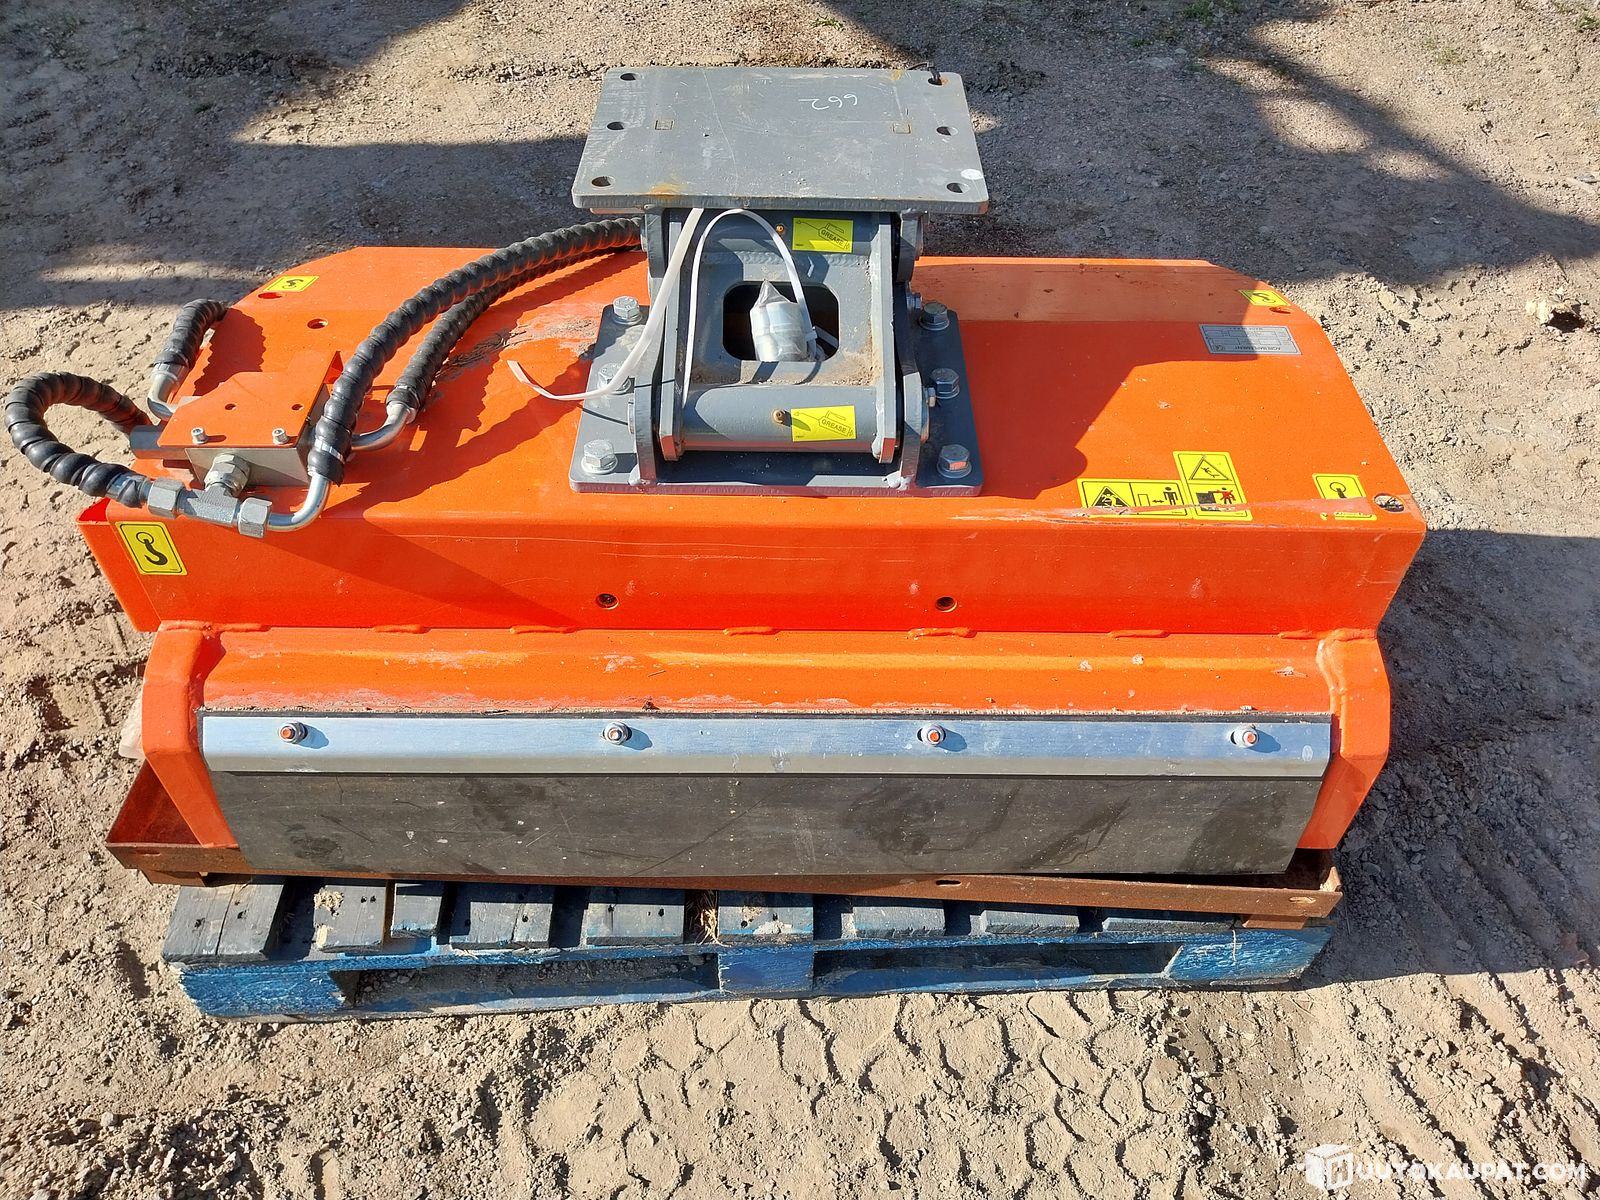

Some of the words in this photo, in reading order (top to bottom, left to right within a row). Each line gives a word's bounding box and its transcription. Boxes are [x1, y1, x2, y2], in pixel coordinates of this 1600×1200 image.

[798, 93, 858, 110] 662
[821, 229, 845, 246] GREASE
[821, 418, 847, 433] GREASE
